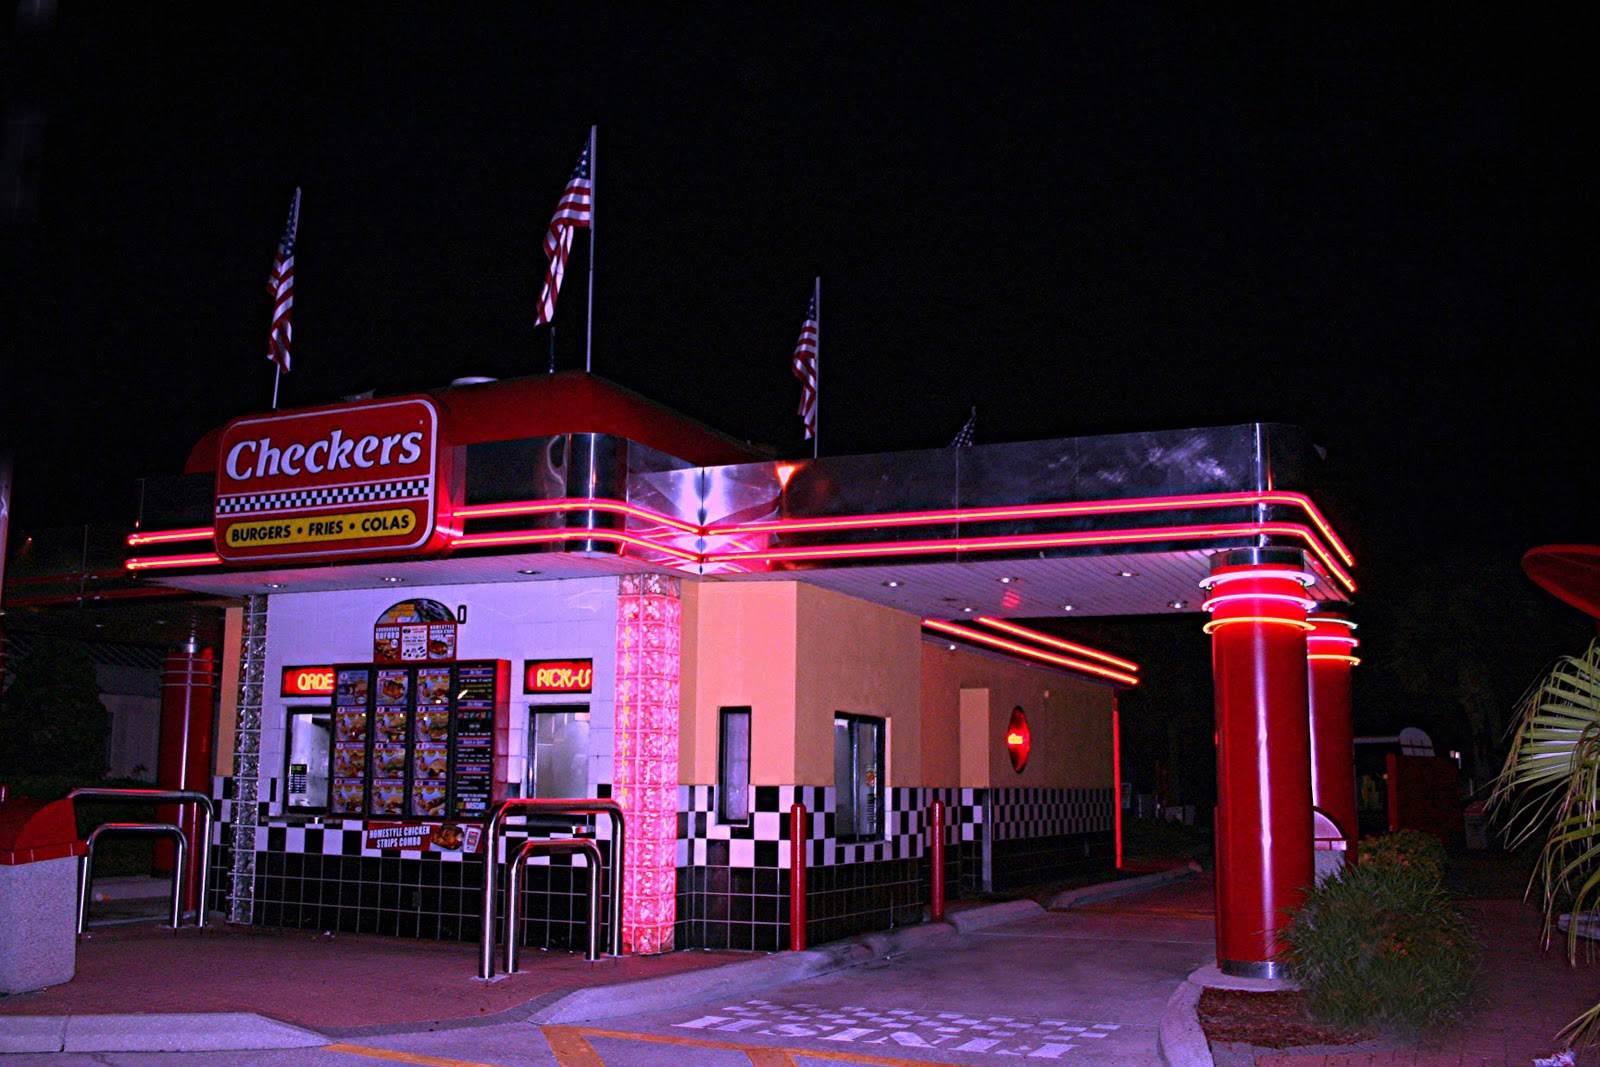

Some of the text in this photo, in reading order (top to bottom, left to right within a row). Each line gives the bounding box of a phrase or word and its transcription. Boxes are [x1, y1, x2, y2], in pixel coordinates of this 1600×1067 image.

[226, 429, 423, 480] Checkers
[232, 515, 410, 542] BURGERS FRIES COLAS
[369, 825, 431, 839] HOMESTYLE CHICKEN
[376, 836, 422, 849] STRIPS COMBO
